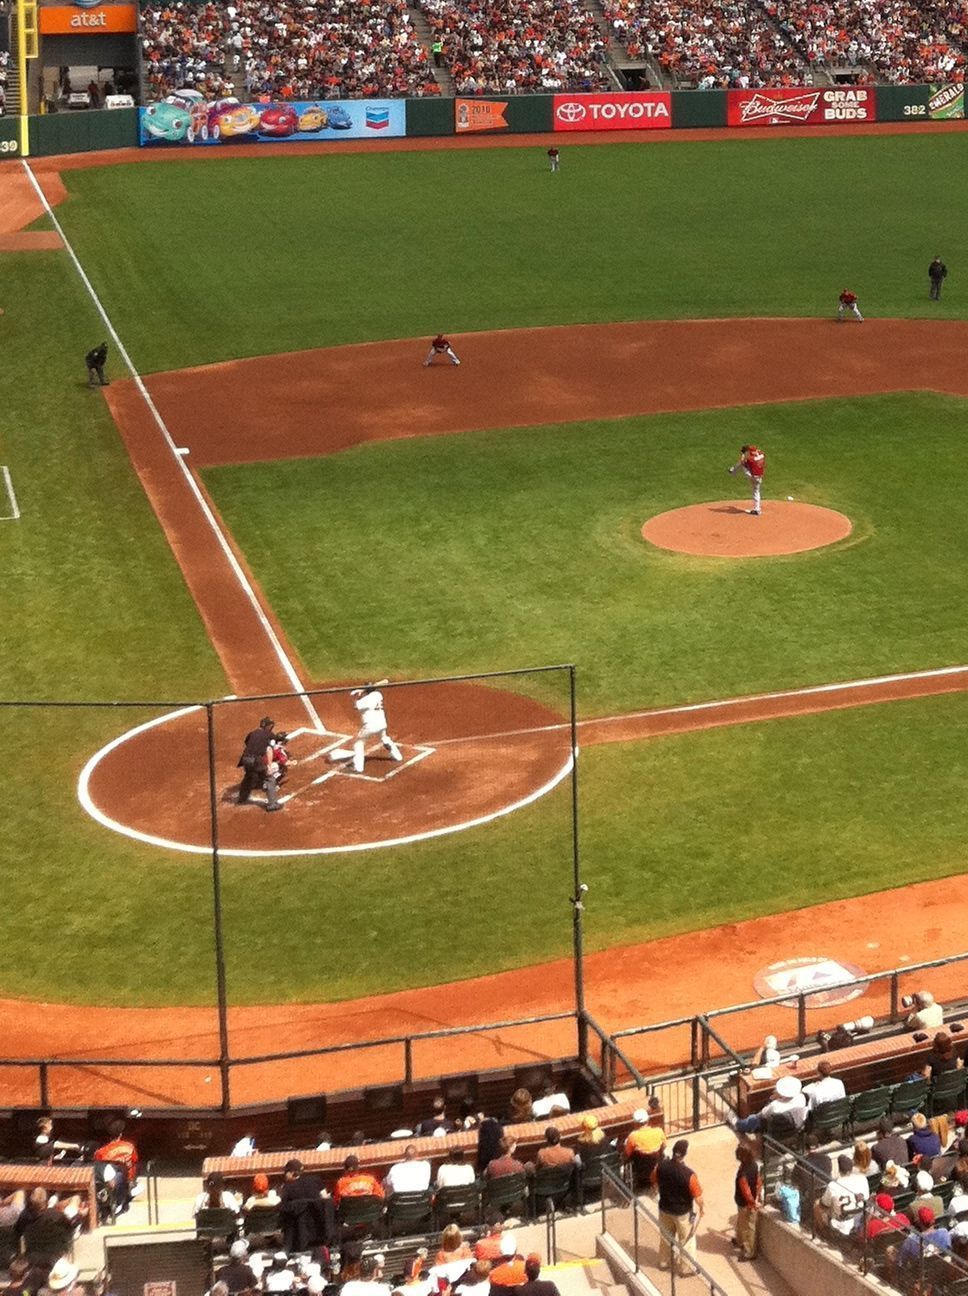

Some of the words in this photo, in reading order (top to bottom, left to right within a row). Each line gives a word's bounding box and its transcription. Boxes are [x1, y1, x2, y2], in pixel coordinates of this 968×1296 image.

[70, 11, 108, 27] at&t
[824, 90, 867, 102] GRAB
[929, 83, 964, 110] EMERALD
[589, 102, 669, 119] TOYOTA
[739, 100, 818, 116] Budweiser
[825, 108, 867, 120] BUDS
[903, 105, 926, 115] 382
